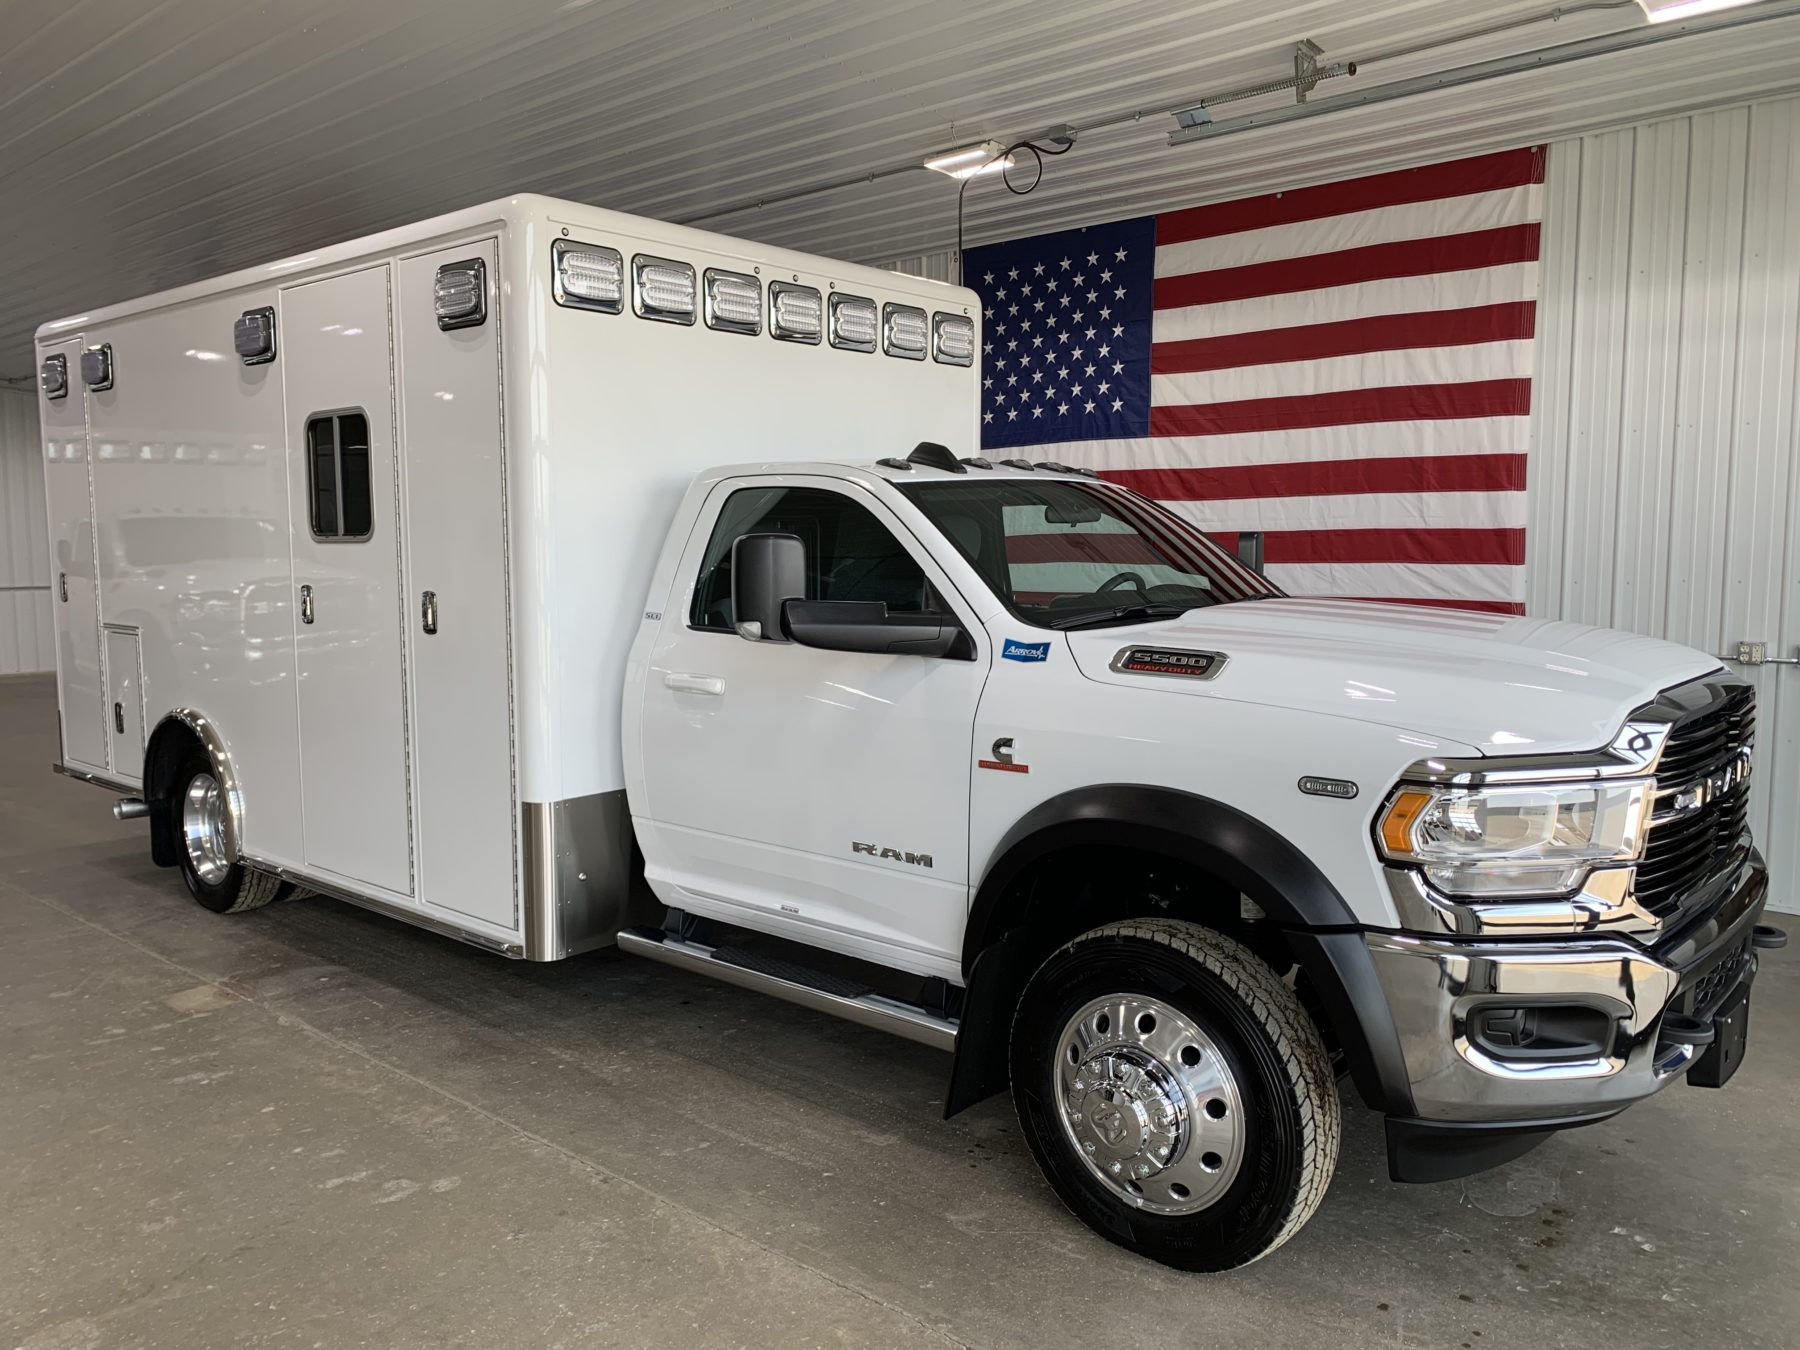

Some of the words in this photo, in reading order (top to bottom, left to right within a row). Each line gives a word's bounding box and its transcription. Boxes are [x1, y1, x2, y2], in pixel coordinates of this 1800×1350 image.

[1134, 652, 1207, 667] 5500
[1128, 663, 1166, 672] HEAVY
[1167, 666, 1202, 675] DUTY
[852, 840, 933, 868] RAM
